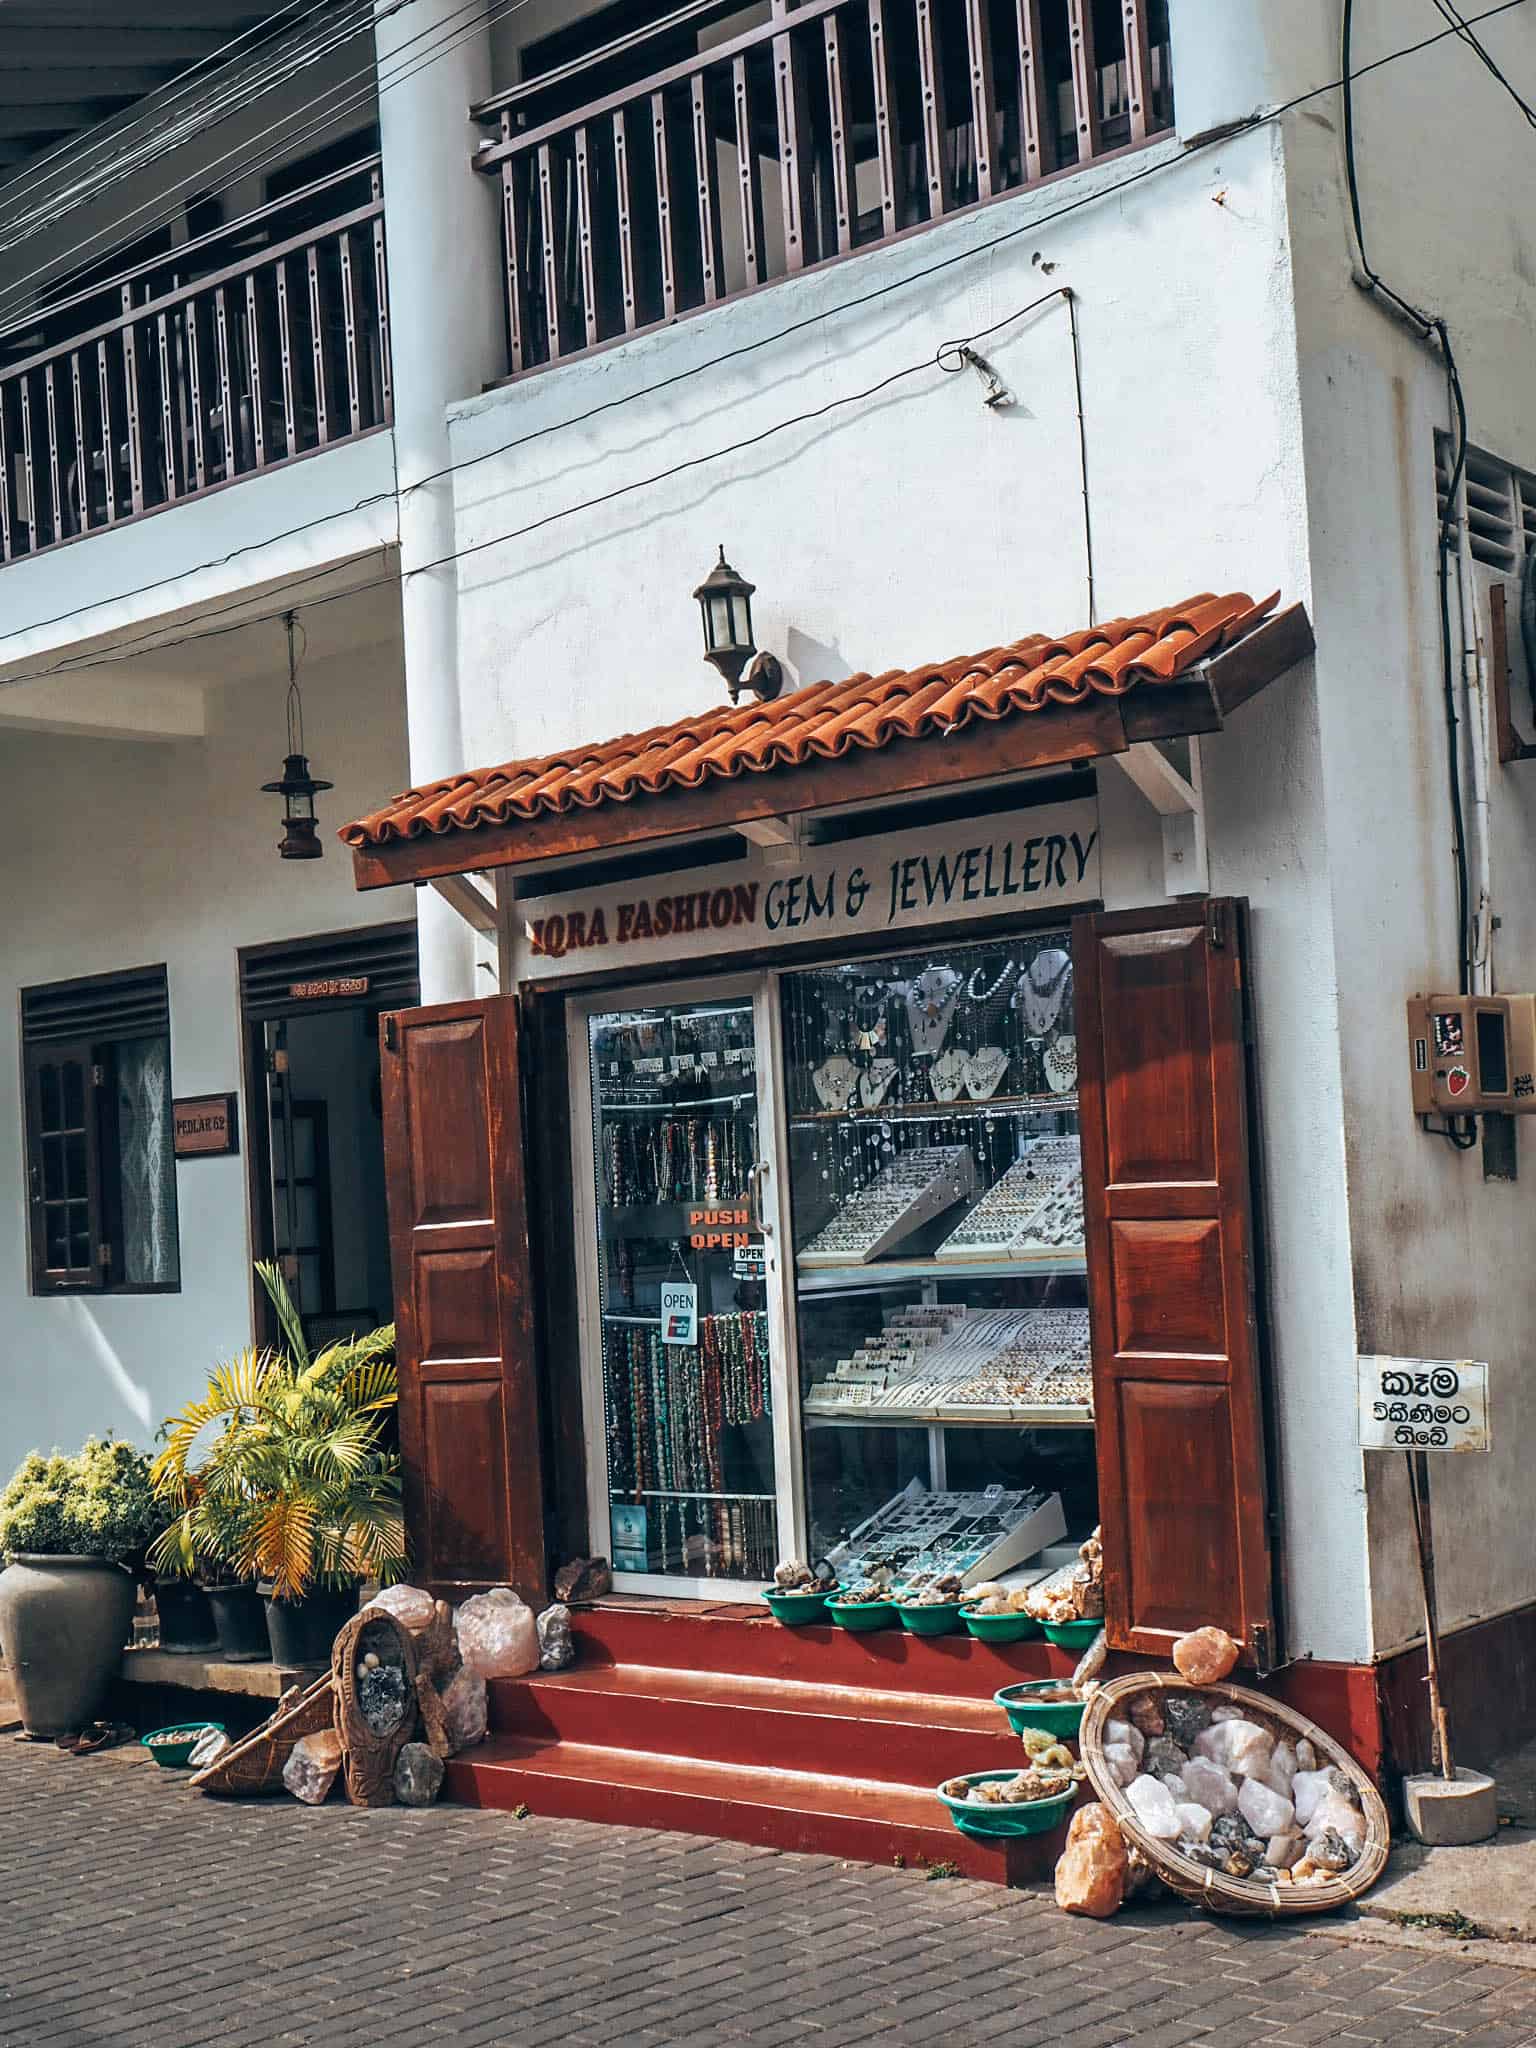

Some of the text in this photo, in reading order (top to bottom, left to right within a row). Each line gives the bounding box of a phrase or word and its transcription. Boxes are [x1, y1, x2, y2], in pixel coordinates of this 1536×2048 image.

[531, 831, 1097, 958] IQRA FASHION GEM & JEWELLERY
[690, 1209, 749, 1226] PUSH
[690, 1232, 749, 1249] OPEN
[739, 1248, 763, 1260] OPEN
[663, 1294, 694, 1309] OPEN
[1381, 1366, 1459, 1399] කෑම
[1394, 1425, 1449, 1446] තිබේ
